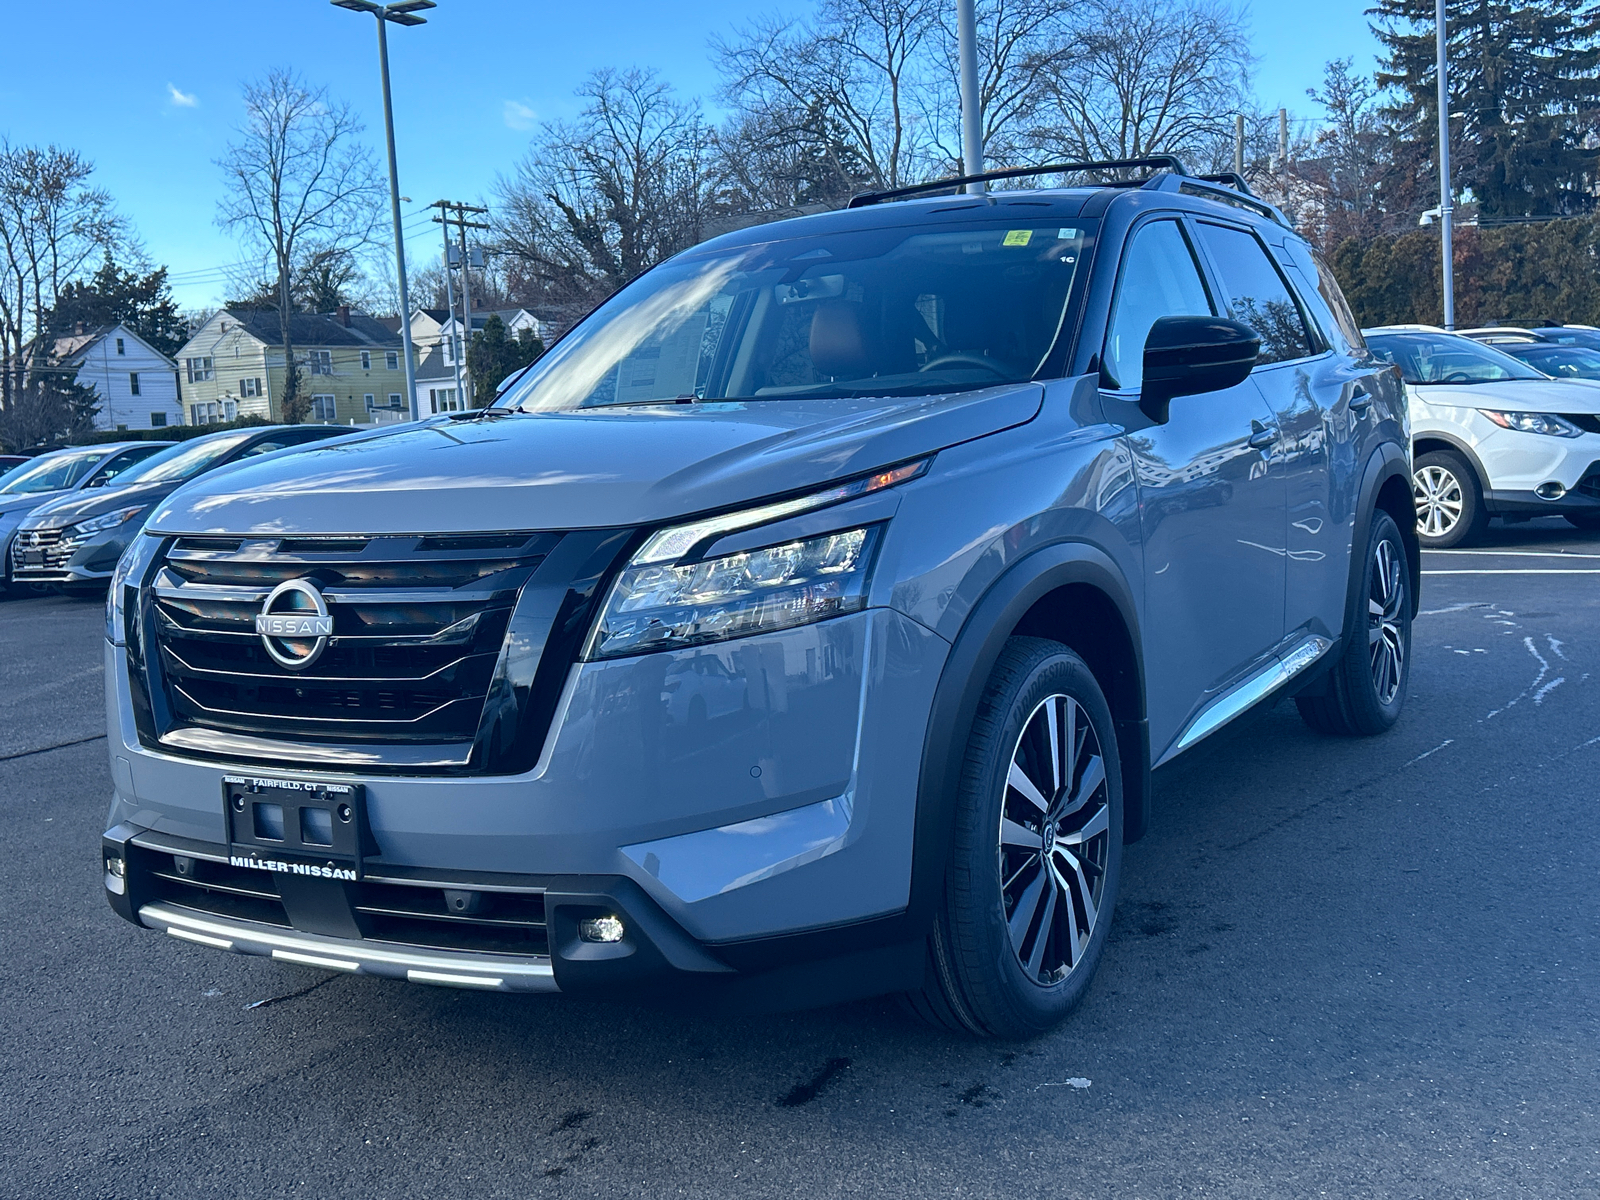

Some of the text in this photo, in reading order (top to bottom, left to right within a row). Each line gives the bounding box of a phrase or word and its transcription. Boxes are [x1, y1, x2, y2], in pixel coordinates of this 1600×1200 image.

[257, 619, 330, 633] NISSAN
[253, 778, 318, 791] FAIRFIELD, CT
[230, 855, 357, 881] MILLER NISSAN
